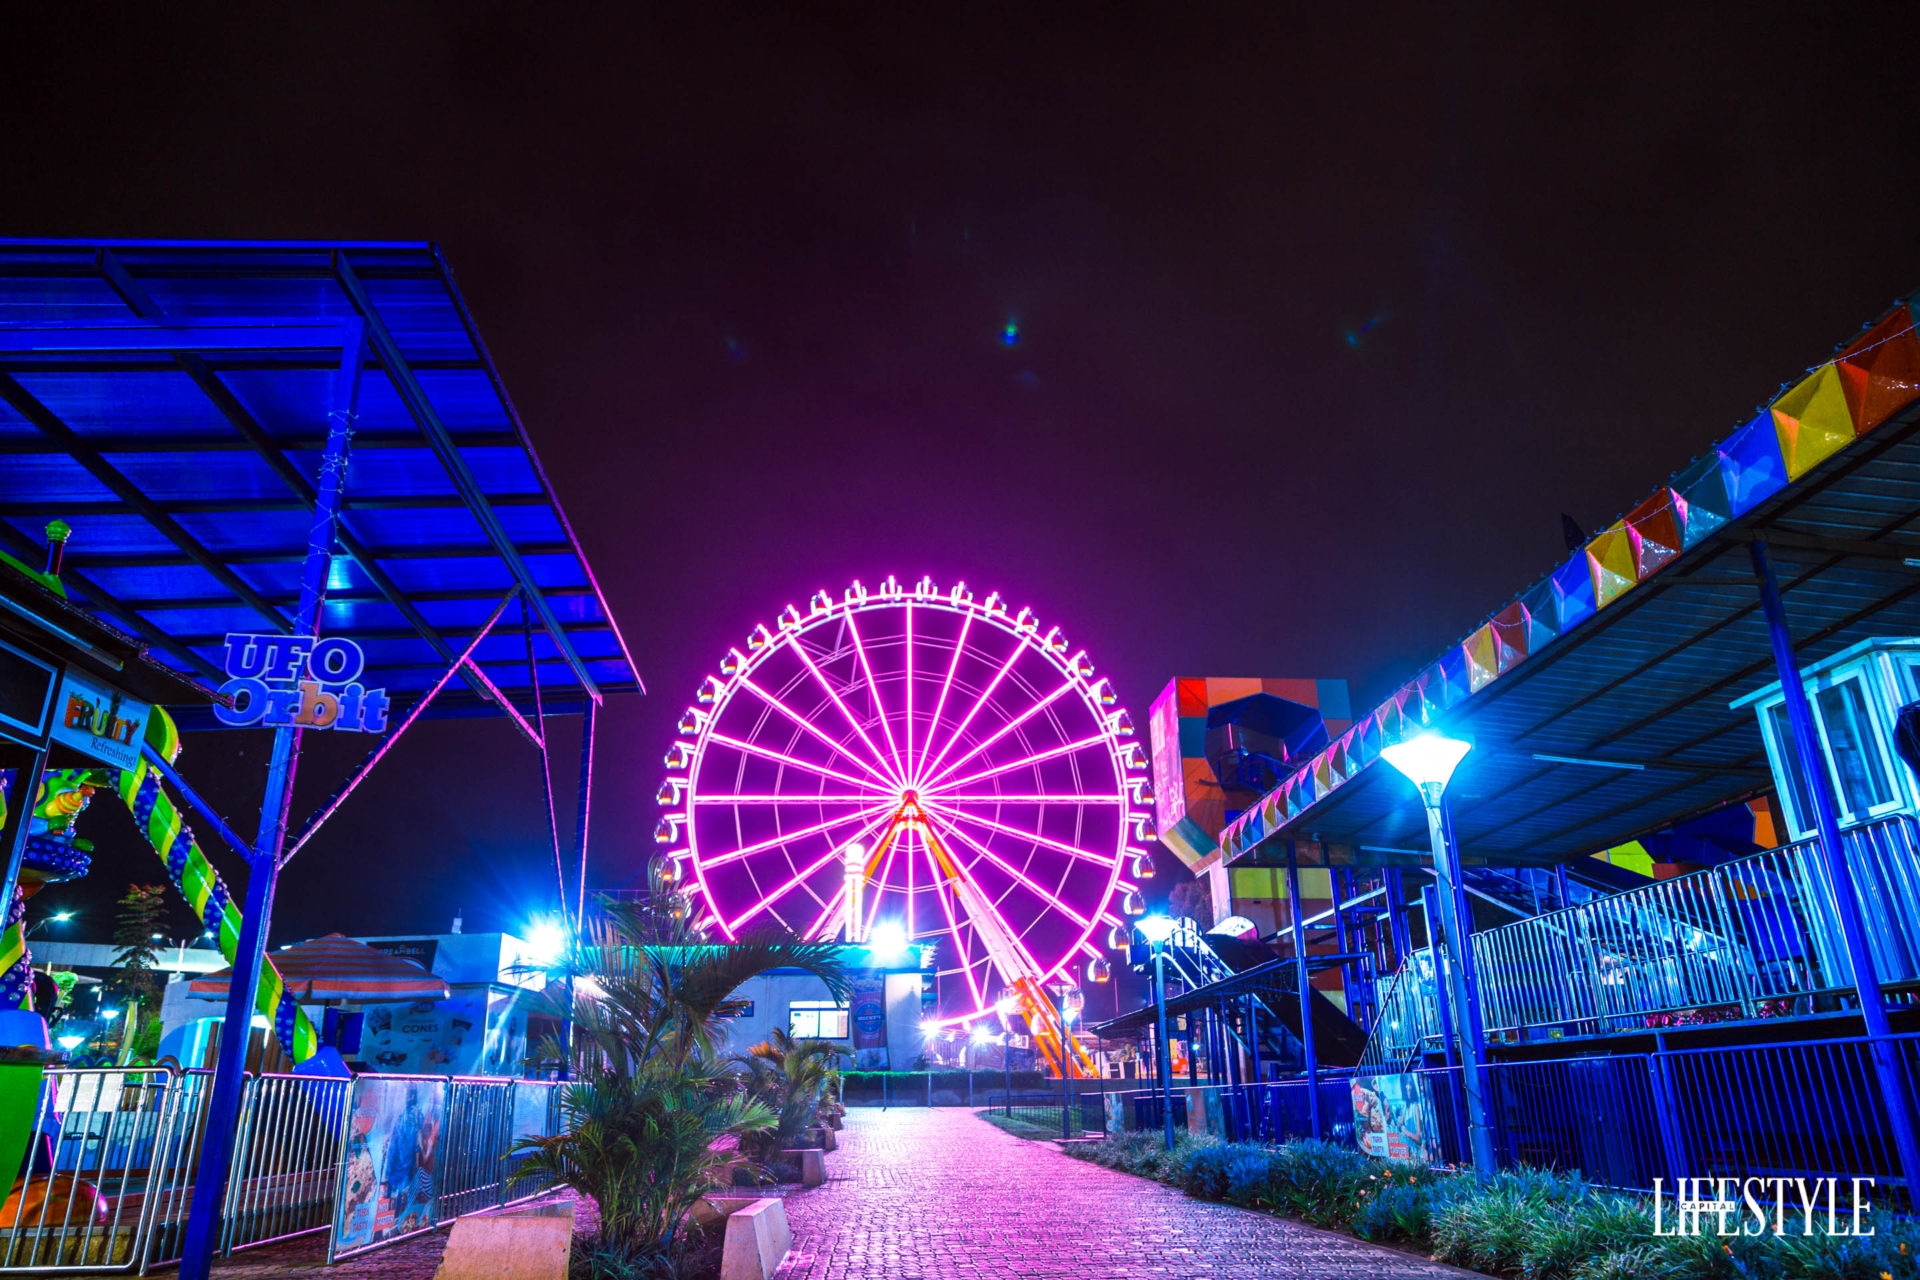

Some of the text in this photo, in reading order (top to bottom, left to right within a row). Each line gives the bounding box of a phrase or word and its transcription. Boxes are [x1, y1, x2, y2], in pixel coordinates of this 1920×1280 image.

[224, 633, 364, 685] UFO
[64, 694, 140, 747] FRUITY
[213, 678, 390, 733] Orbit
[91, 737, 136, 767] Refreshing!
[402, 1023, 439, 1034] CONES
